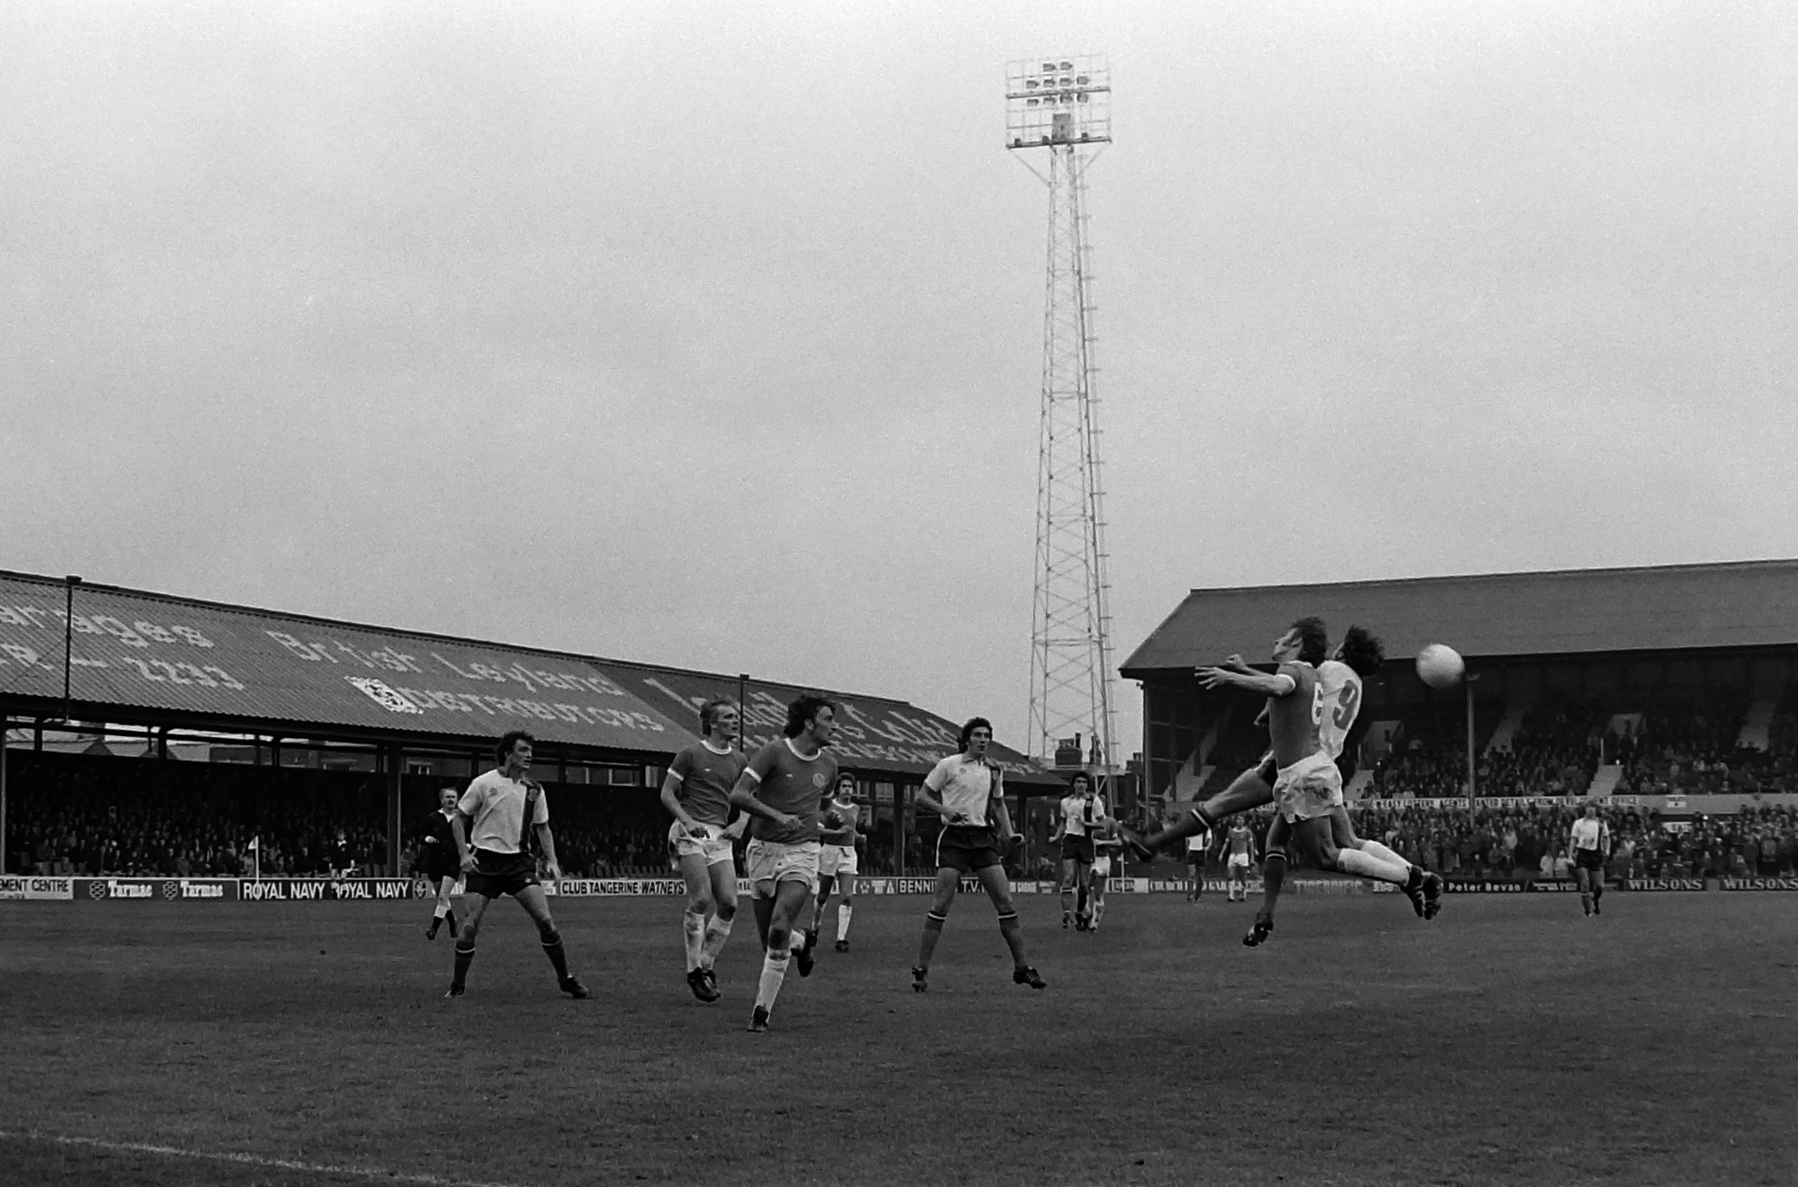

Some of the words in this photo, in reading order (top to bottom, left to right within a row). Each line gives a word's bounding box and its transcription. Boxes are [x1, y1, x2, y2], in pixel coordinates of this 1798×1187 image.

[265, 630, 423, 674] Brtish
[0, 879, 28, 891] MENT
[31, 879, 69, 892] CENTRE
[108, 880, 153, 897] Tarmac
[181, 880, 223, 897] Tarmac
[244, 882, 286, 899] ROYAL
[290, 882, 325, 899] NAVY
[376, 882, 409, 898] NAVY
[562, 882, 587, 895] CLUB
[589, 882, 638, 895] TANGERINE
[641, 881, 685, 895] WATNEYS
[1448, 882, 1482, 892] Peter
[1485, 882, 1521, 892] Bevan
[1628, 879, 1703, 891] WILSONS
[1724, 879, 1798, 891] WILSONS
